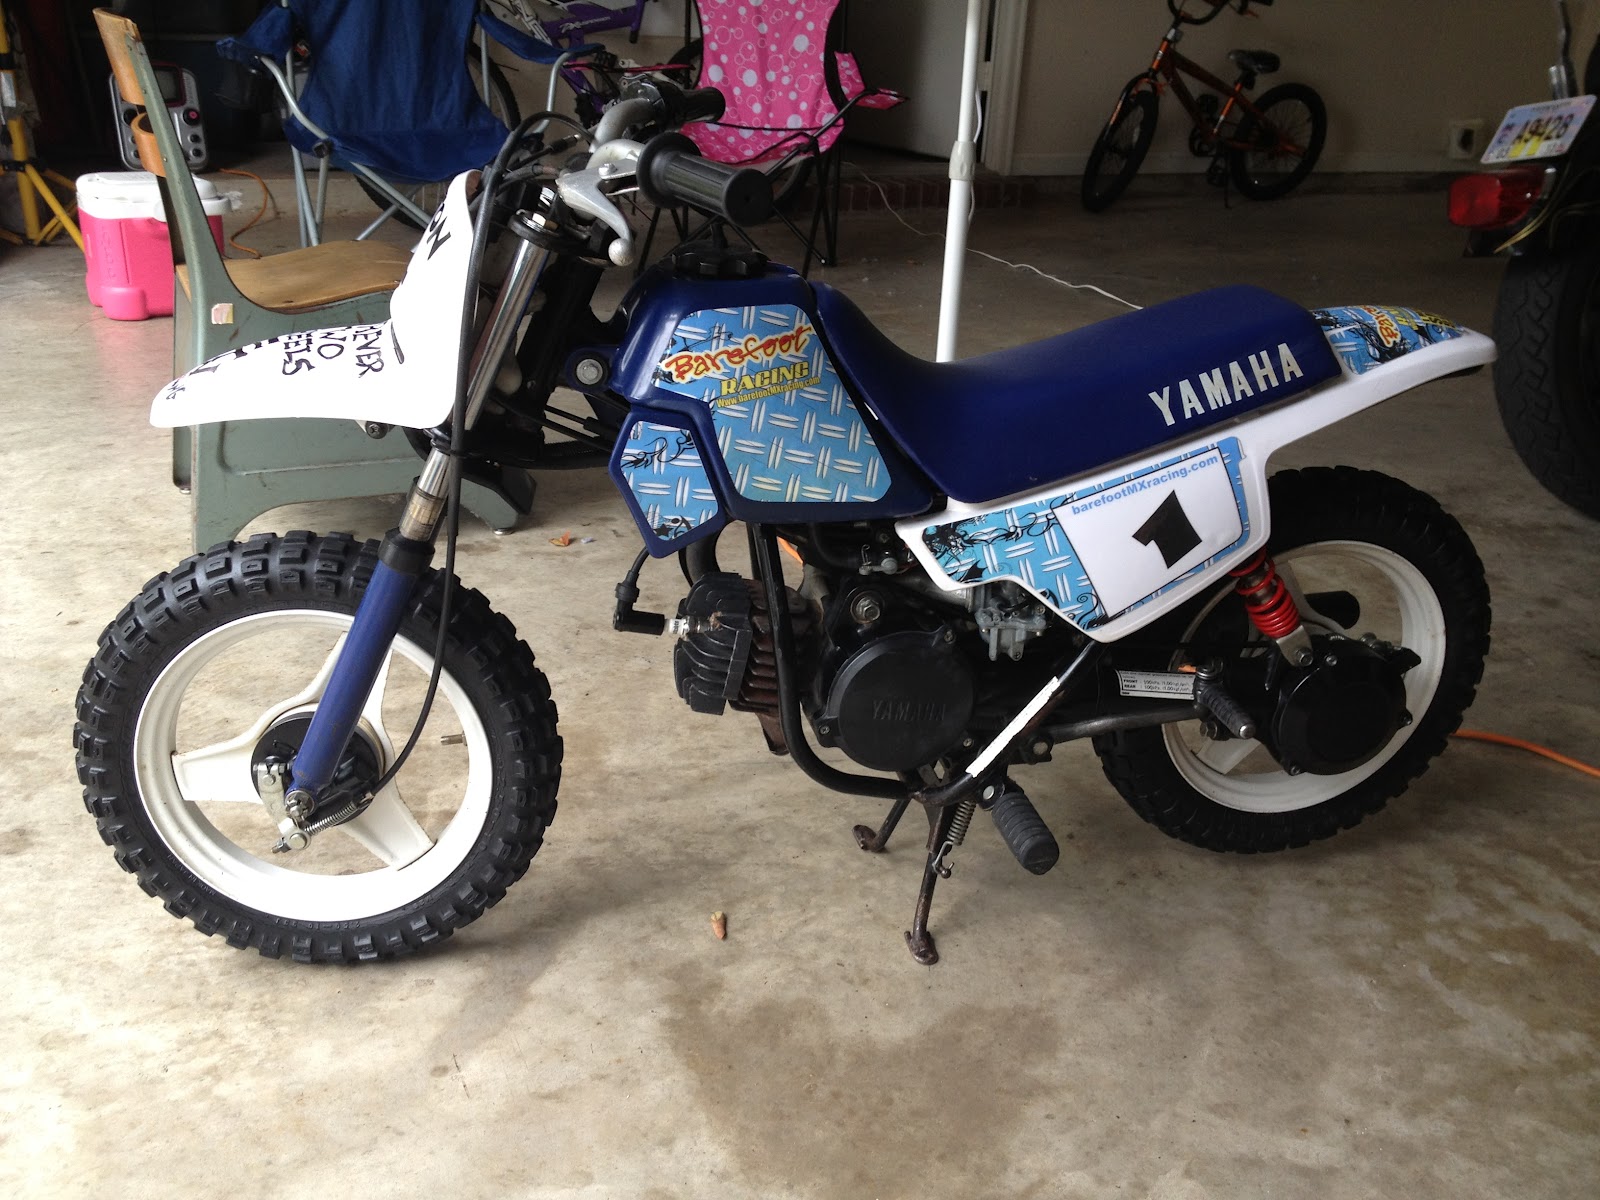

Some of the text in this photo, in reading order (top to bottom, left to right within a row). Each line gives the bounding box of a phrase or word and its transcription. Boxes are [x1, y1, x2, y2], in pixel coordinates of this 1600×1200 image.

[662, 324, 813, 382] Barefoot
[720, 361, 809, 396] RACING
[1148, 343, 1304, 427] YAMAHA
[1071, 454, 1219, 516] barefootMXracing.com
[1132, 489, 1203, 569] 1
[872, 699, 946, 721] YAMAHA
